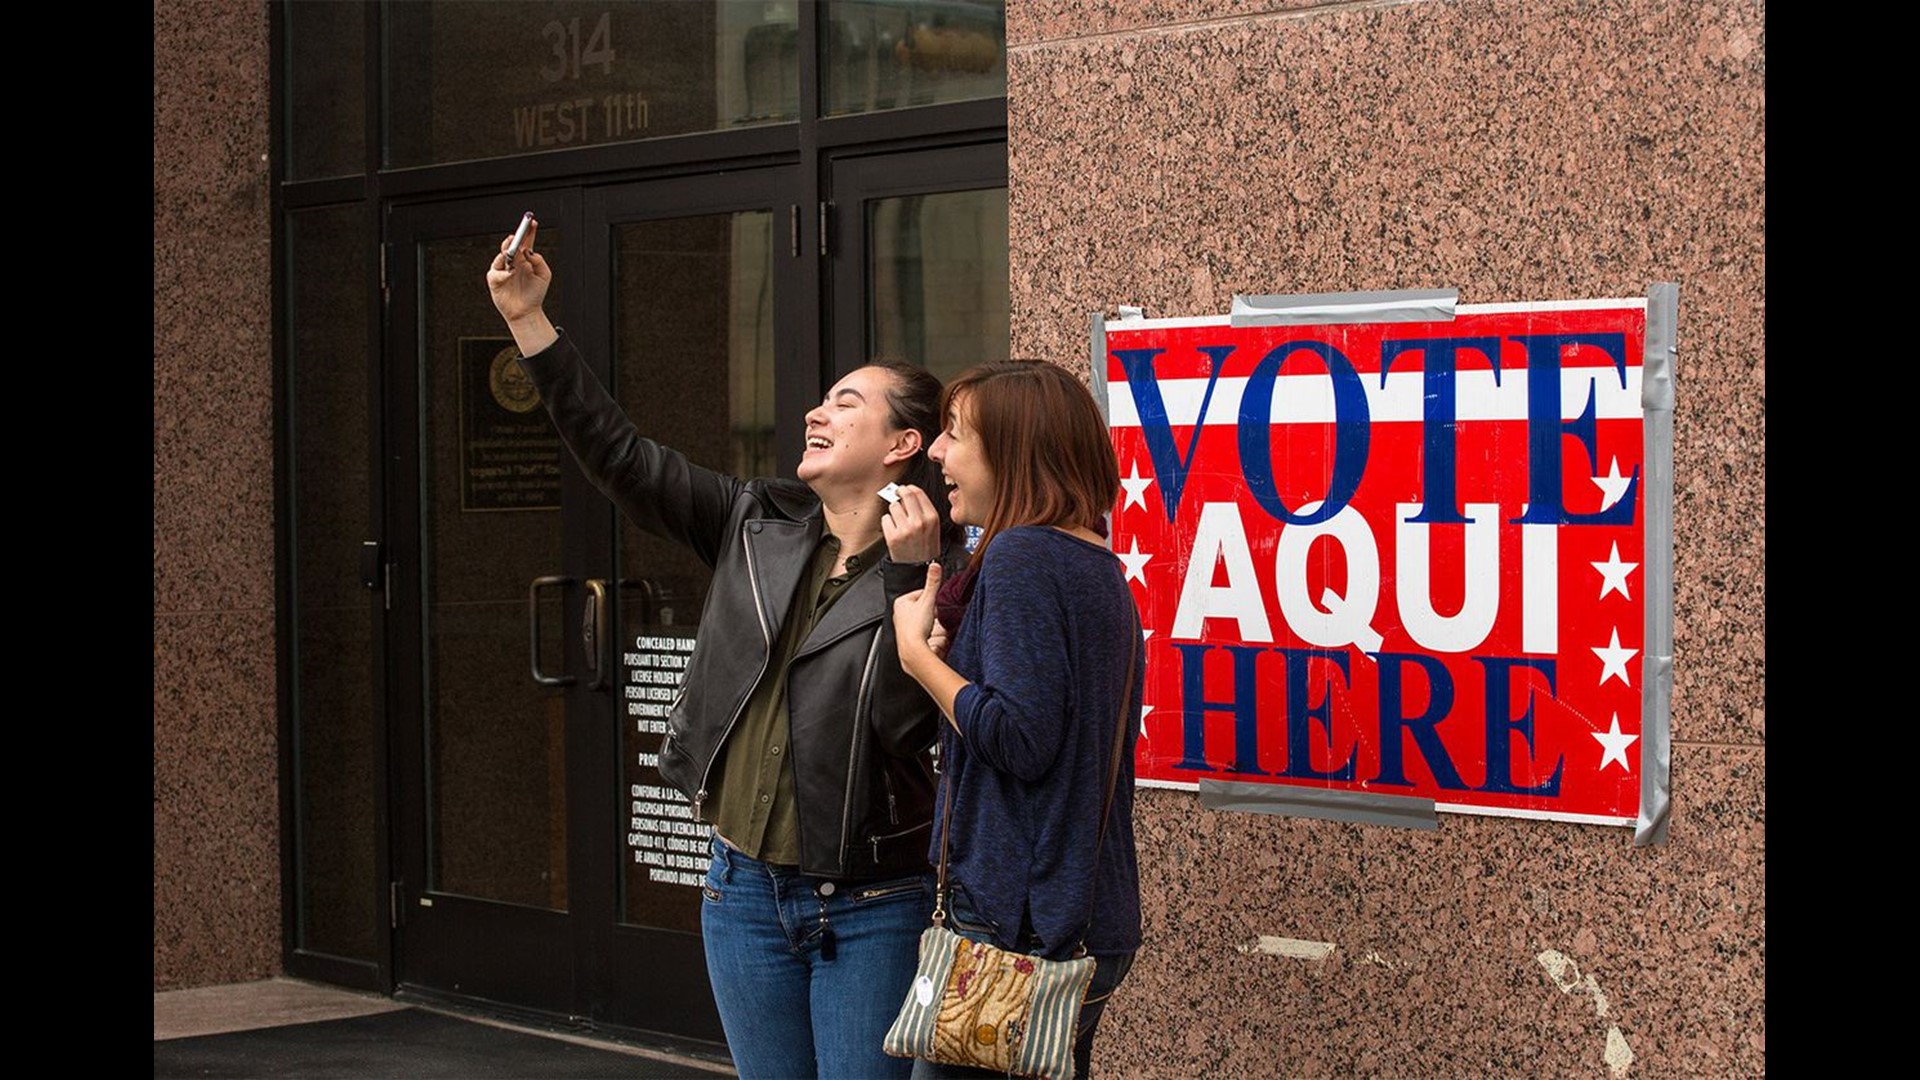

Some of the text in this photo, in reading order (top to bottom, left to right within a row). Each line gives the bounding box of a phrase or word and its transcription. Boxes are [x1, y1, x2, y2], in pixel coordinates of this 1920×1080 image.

[541, 12, 615, 82] 314
[513, 92, 648, 148] WEST 11th
[1111, 332, 1639, 526] VOTE
[1170, 500, 1558, 662] AQUI
[636, 636, 675, 651] CONCEALED
[624, 652, 651, 666] PURSUANT
[652, 654, 660, 667] TO
[660, 655, 683, 668] SECTION
[631, 670, 653, 683] LICENSE
[653, 671, 674, 684] HOLDER
[625, 686, 646, 699] PERSON
[646, 687, 671, 701] LICENSED
[628, 702, 664, 716] GOVERNMENT
[638, 720, 667, 734] NOT ENTER
[1171, 643, 1564, 797] HERE
[631, 784, 661, 799] CONFORME
[661, 787, 666, 799] A
[666, 787, 674, 800] LA
[631, 817, 711, 838] PERSONAS CON LICENCIA BAJO
[690, 840, 698, 853] DE
[635, 850, 643, 863] DE
[666, 853, 676, 867] NO
[676, 855, 694, 869] DEBEN
[649, 868, 679, 884] PORTANDO
[679, 872, 699, 887] ARMAS
